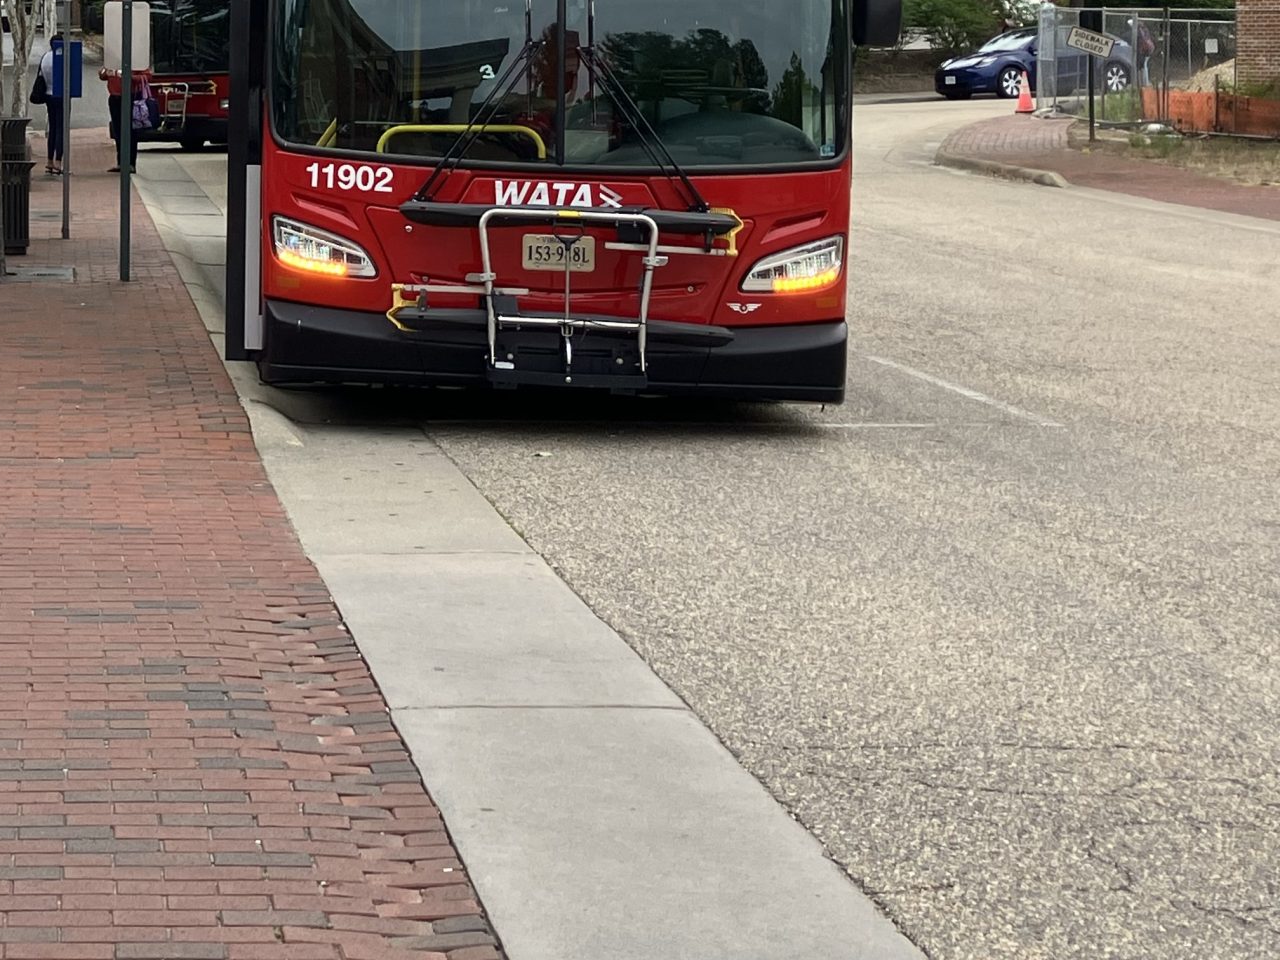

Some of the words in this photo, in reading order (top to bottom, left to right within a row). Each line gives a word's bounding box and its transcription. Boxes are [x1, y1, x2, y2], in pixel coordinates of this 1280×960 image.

[1073, 29, 1110, 47] SIDEWALK
[1074, 38, 1105, 54] CLOSED
[305, 162, 395, 193] 11902
[494, 180, 594, 208] WATA
[527, 245, 590, 264] 153-98L
